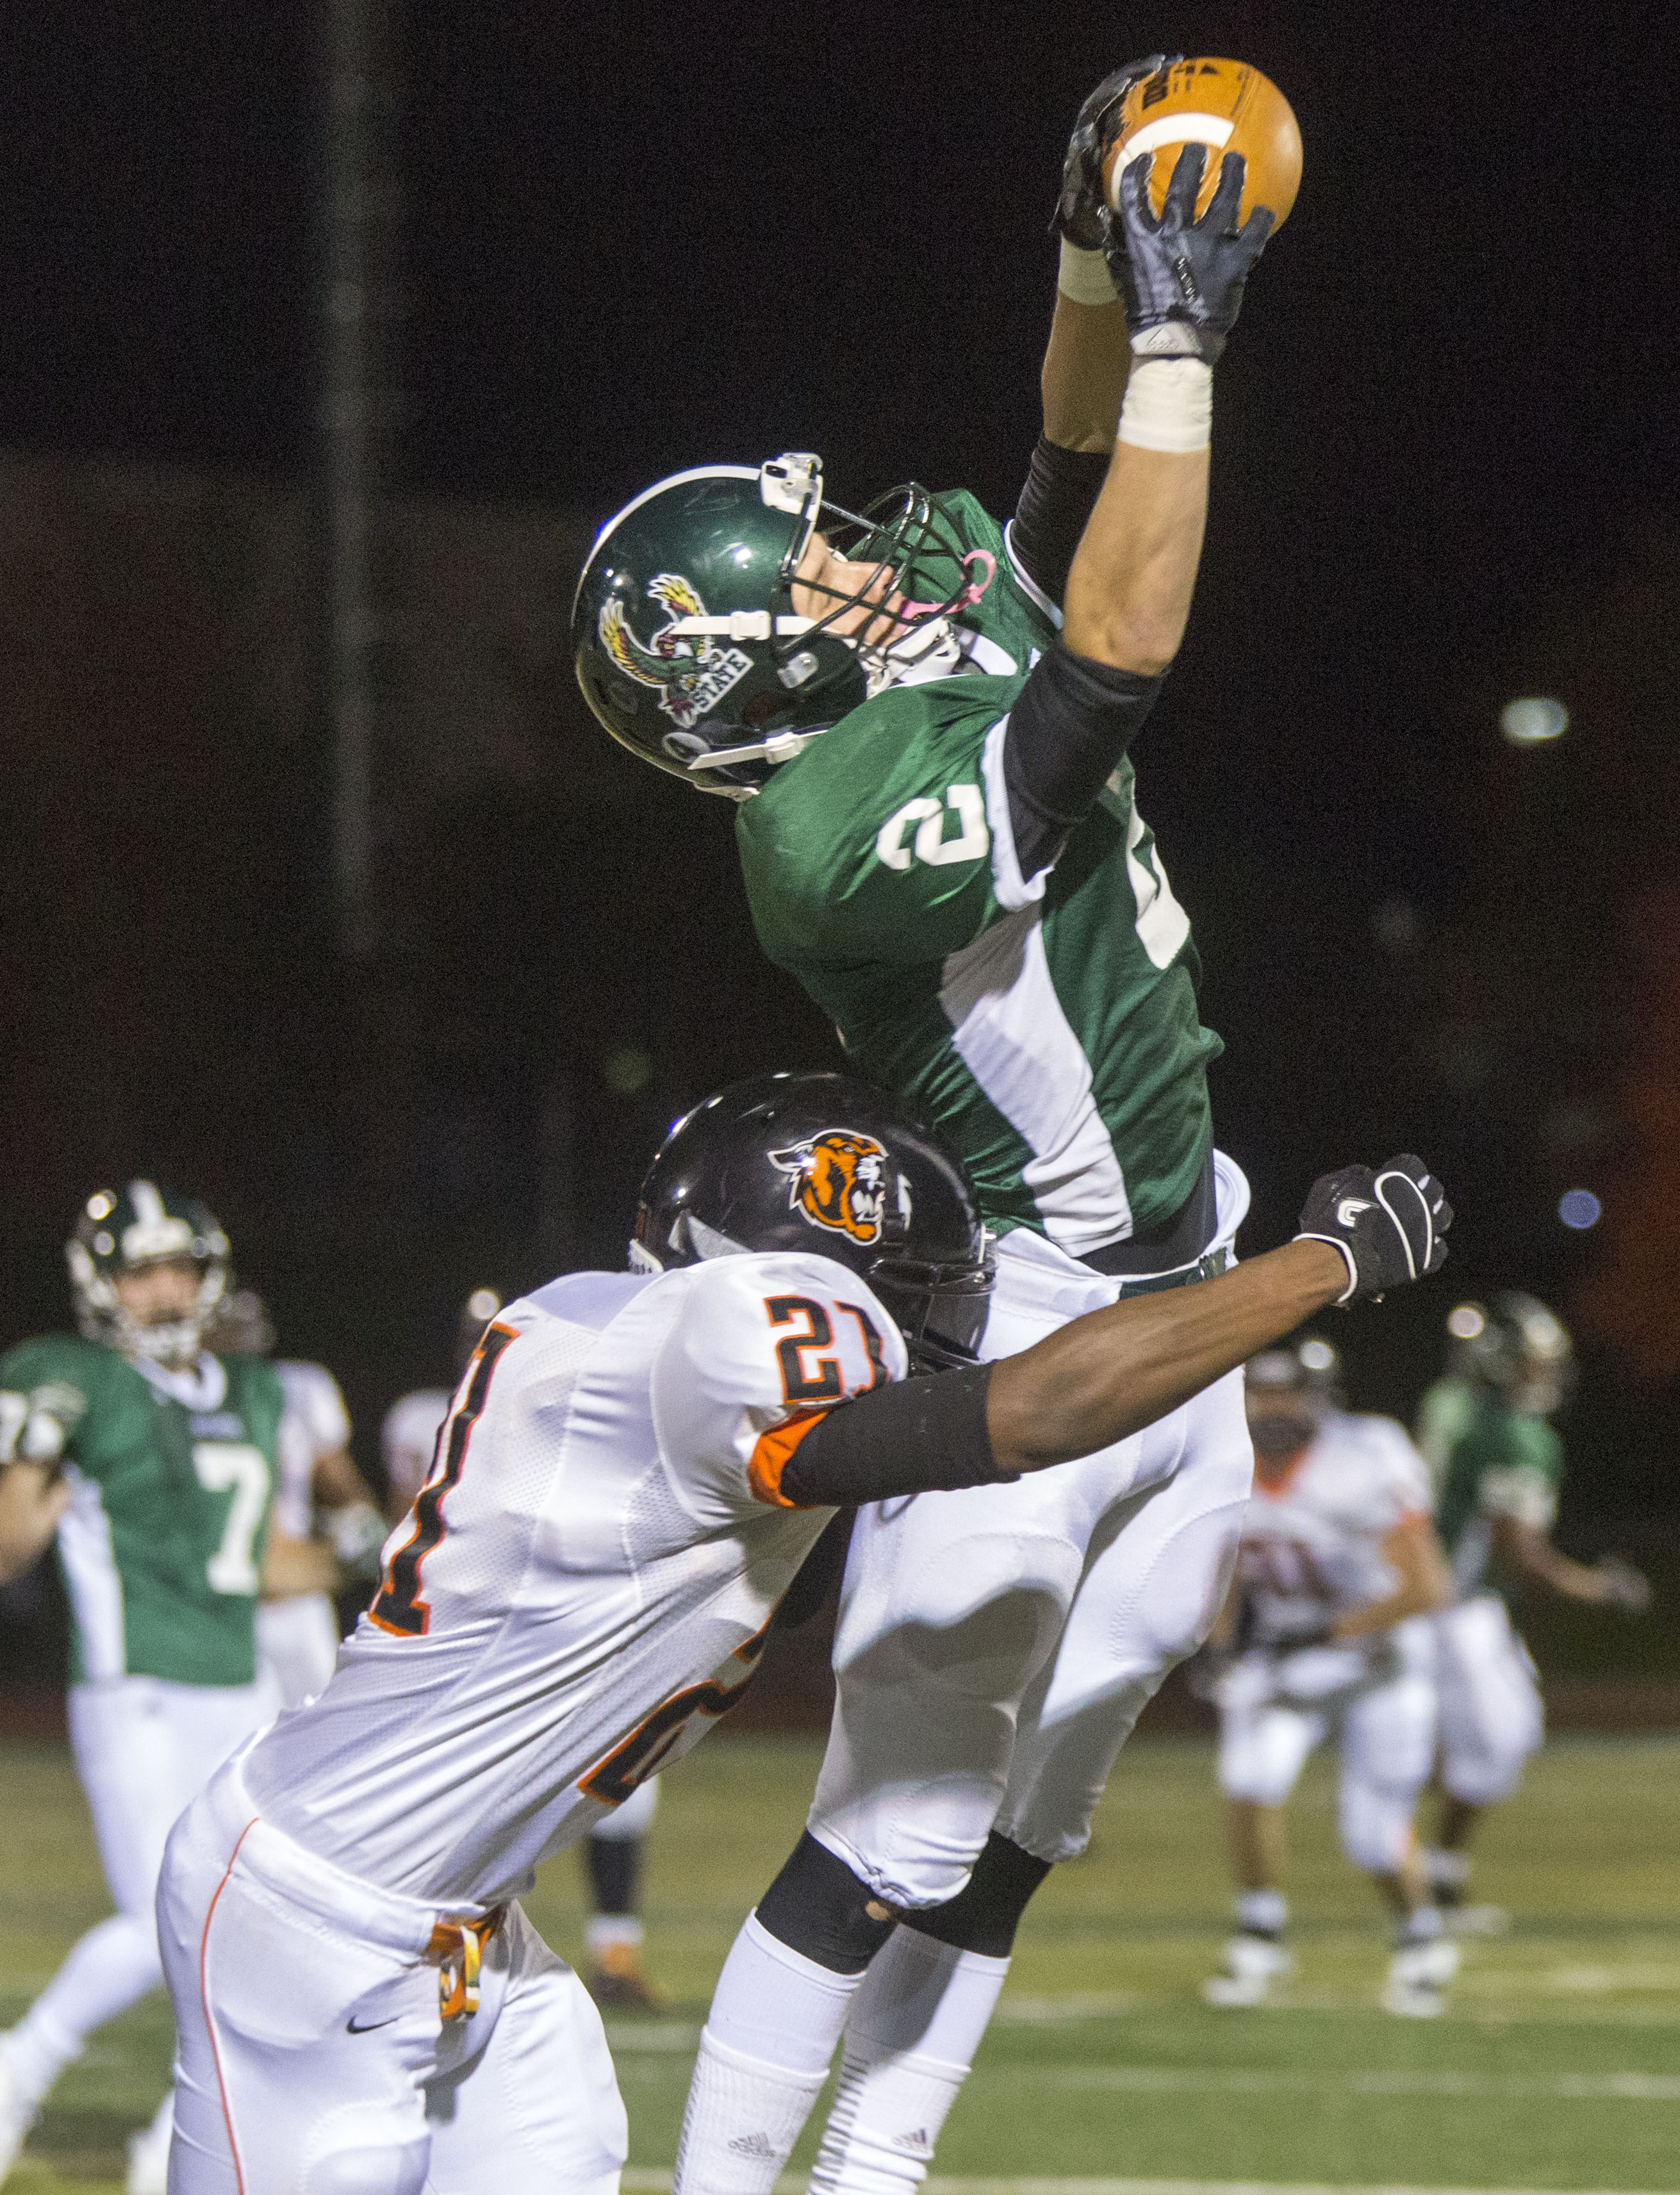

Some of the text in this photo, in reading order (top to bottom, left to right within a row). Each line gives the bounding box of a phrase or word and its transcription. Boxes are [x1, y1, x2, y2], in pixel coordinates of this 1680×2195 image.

[692, 652, 748, 708] STATE
[875, 784, 989, 870] 2
[763, 1294, 893, 1404] 21
[194, 1440, 269, 1597] 7
